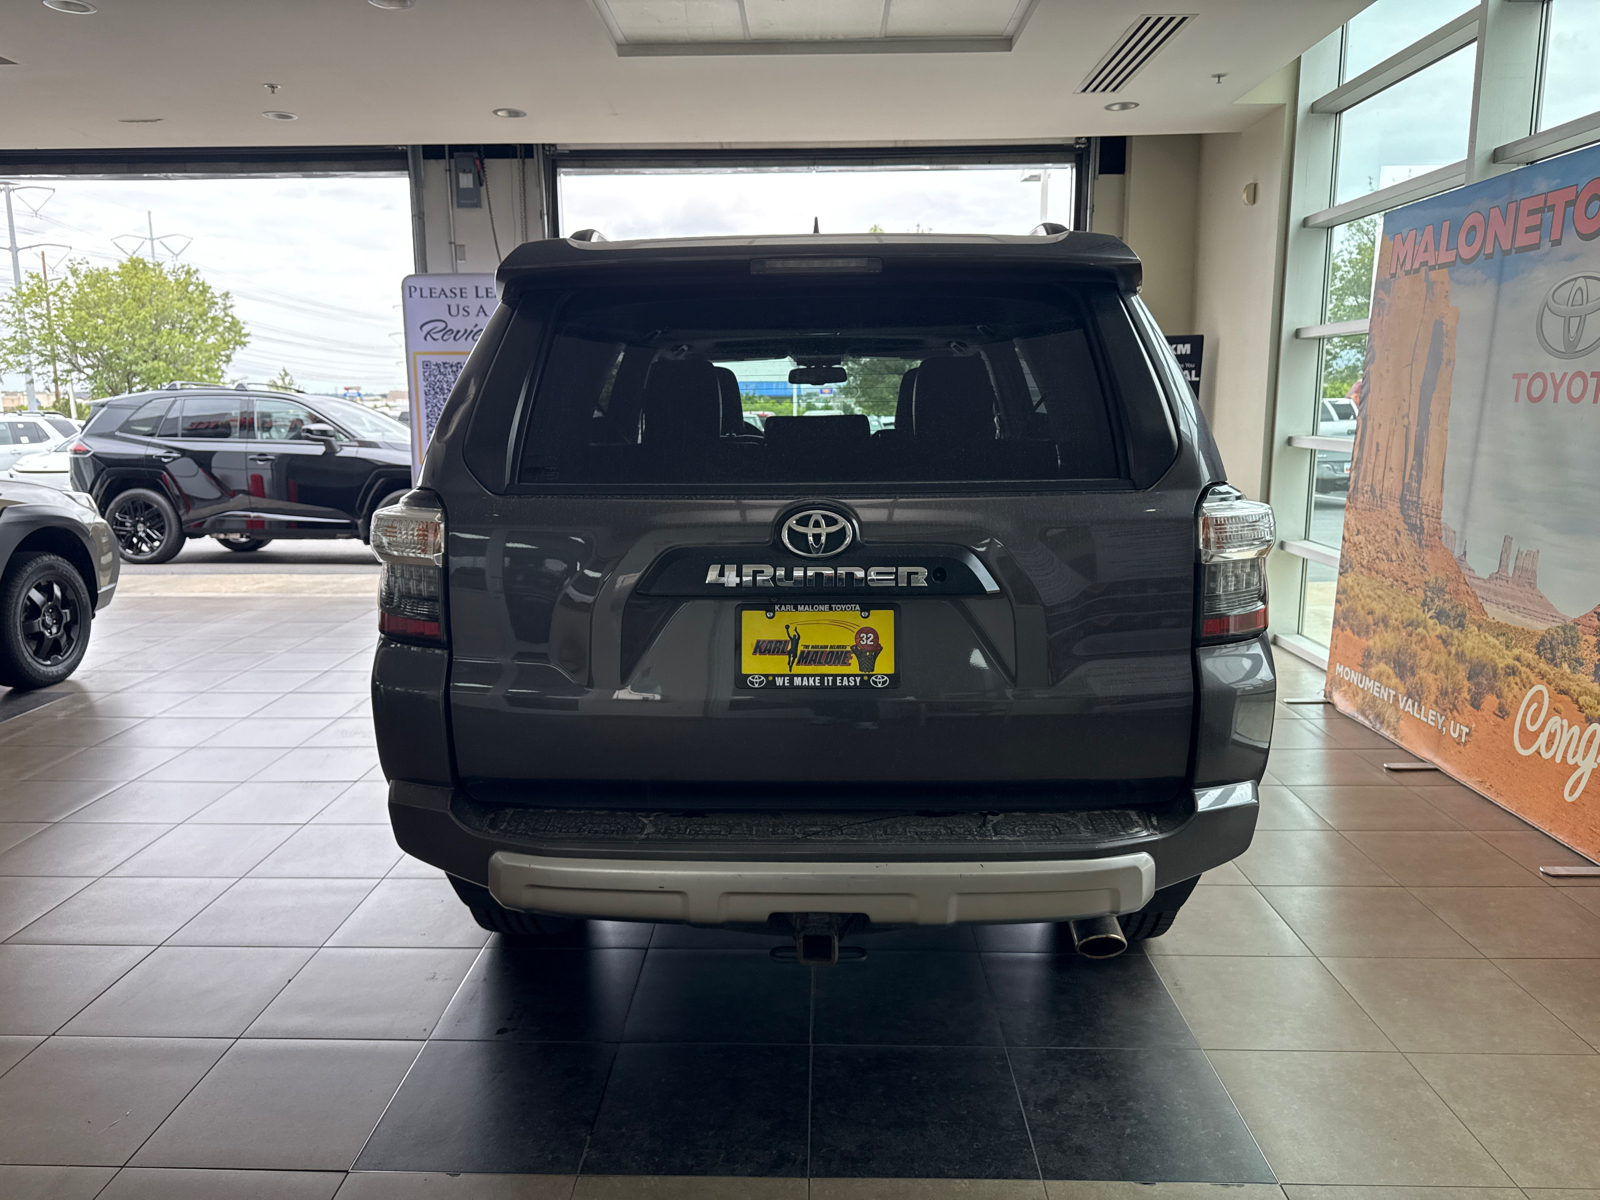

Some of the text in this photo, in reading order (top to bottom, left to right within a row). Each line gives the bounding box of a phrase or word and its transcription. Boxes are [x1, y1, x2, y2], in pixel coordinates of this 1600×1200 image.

[1389, 176, 1600, 278] MALONETO
[408, 285, 496, 299] PLEASE LE
[447, 303, 489, 318] US A
[775, 604, 796, 612] KARL
[797, 604, 829, 612] MALONE
[860, 633, 874, 645] 32
[752, 639, 790, 655] KARL
[796, 650, 852, 666] MALONE
[775, 676, 861, 686] WE MAKE IT EASY
[1335, 662, 1470, 743] MONUMENT VALLEY, UT
[1513, 684, 1600, 802] Cong
